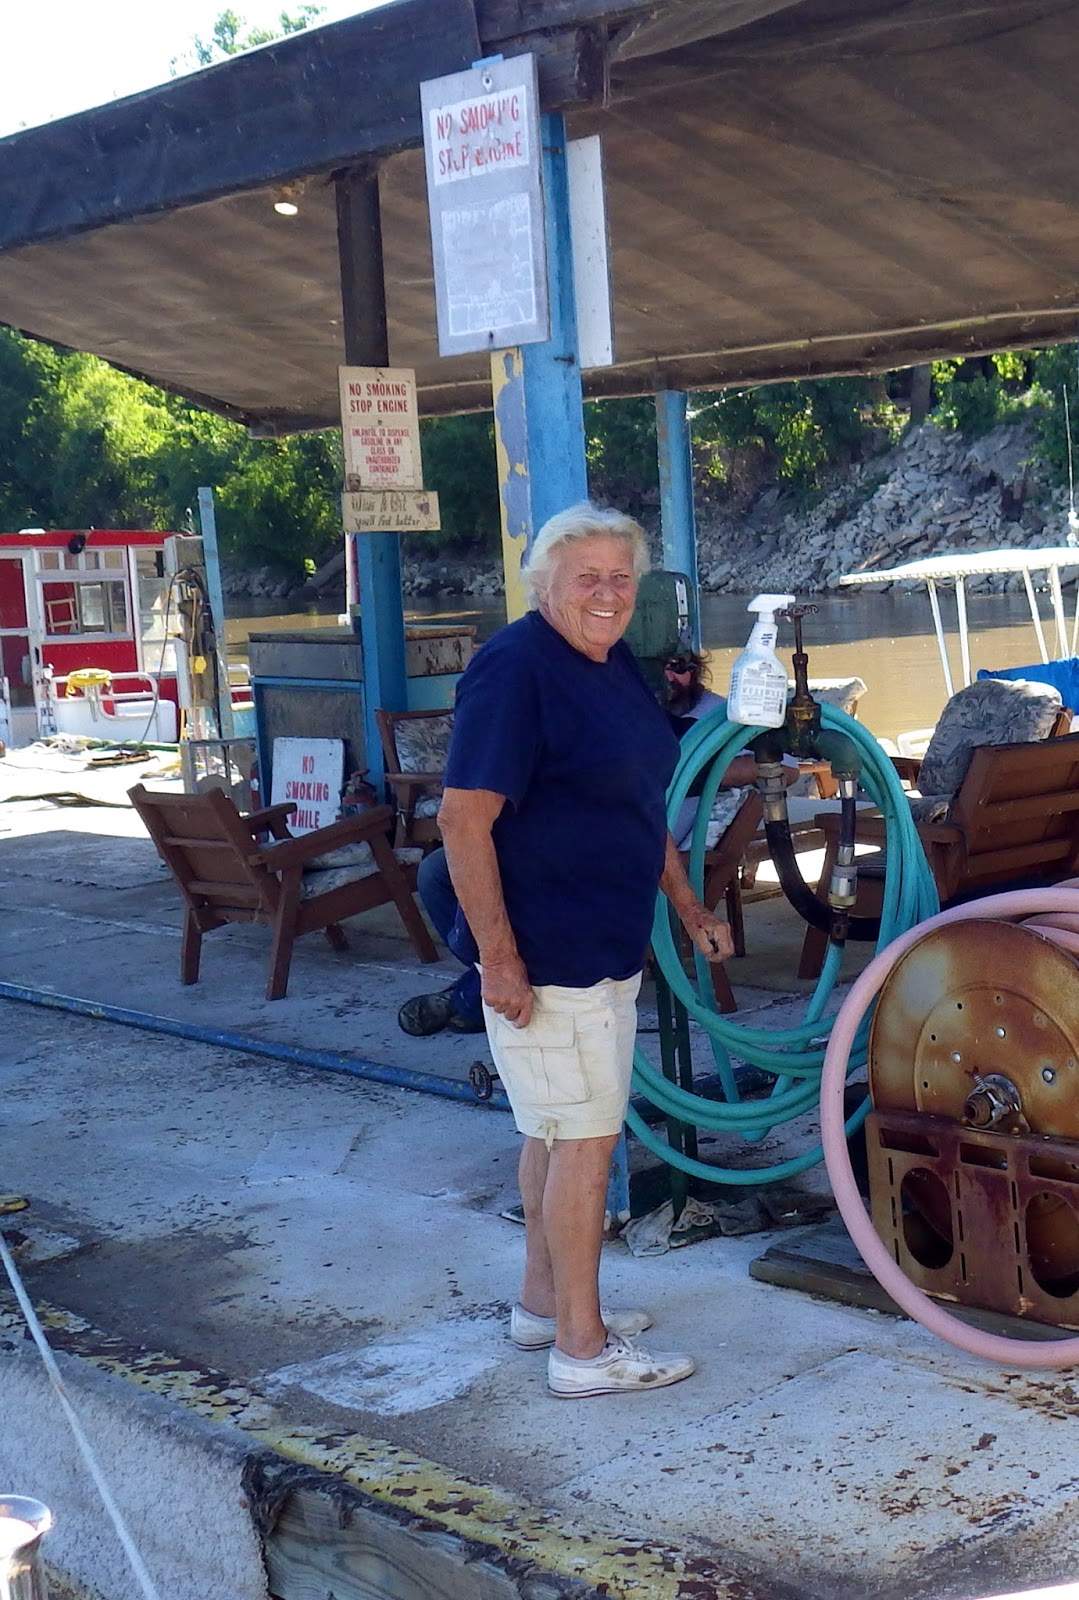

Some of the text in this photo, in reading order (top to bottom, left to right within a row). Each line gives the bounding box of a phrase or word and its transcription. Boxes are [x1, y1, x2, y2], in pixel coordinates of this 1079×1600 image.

[349, 383, 407, 396] NO SMOKING
[350, 400, 408, 413] STOP ENGINE
[379, 428, 386, 437] TO
[387, 428, 410, 437] DISPENSE
[361, 437, 402, 446] GASOLINE IN ANY
[370, 446, 395, 455] GLASS OR
[365, 455, 401, 464] UNAUTHORIZED
[368, 465, 399, 473] CONTAINERS
[302, 755, 315, 774] NO
[285, 781, 329, 802] SMOKING
